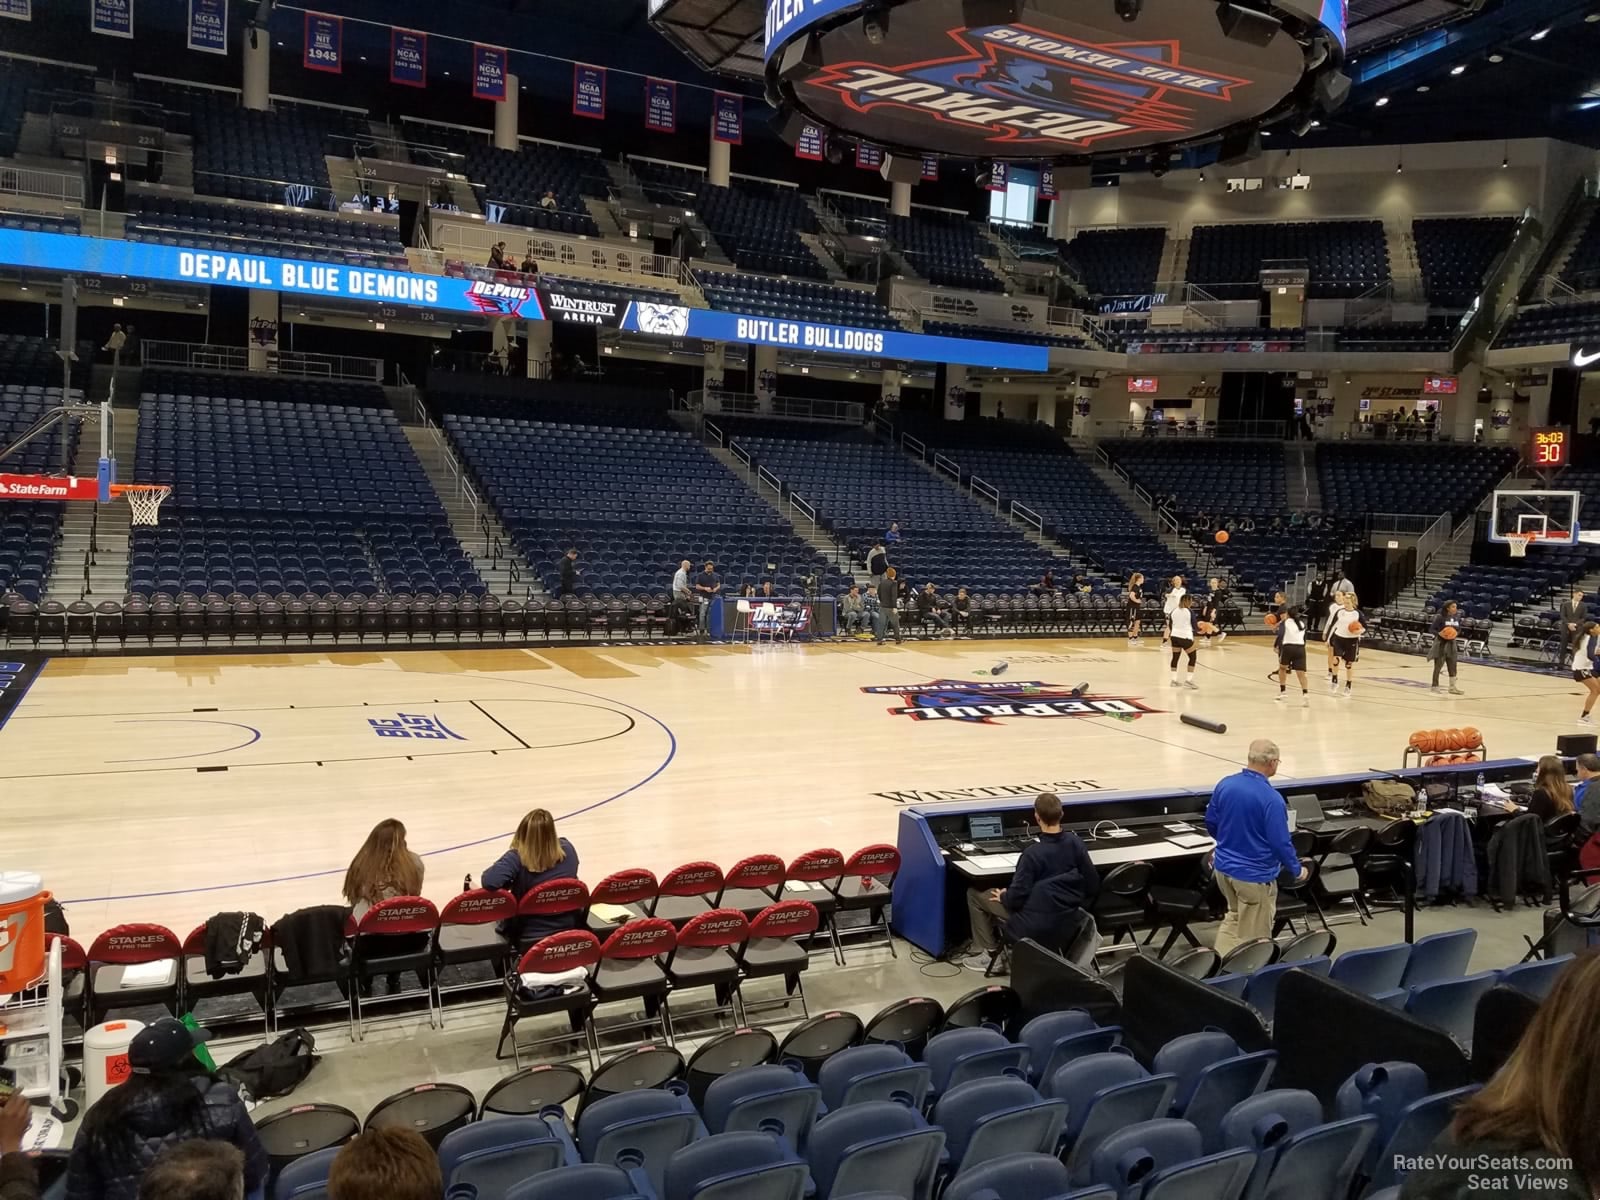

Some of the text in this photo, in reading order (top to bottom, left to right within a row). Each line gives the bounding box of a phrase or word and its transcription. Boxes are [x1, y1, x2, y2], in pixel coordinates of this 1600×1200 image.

[195, 14, 221, 25] NCAA
[316, 34, 331, 44] NIT
[308, 48, 338, 62] 1945
[397, 49, 420, 60] NCAA
[984, 29, 1221, 88] BLUE DEMONS
[479, 64, 501, 75] NCAA
[579, 82, 600, 93] NCAA
[651, 97, 671, 106] NCAA
[838, 69, 1134, 139] DEPAUL
[718, 110, 738, 120] NCAA
[992, 163, 1005, 176] 24
[179, 252, 438, 302] DEPAUL BLUE DEMONS
[550, 293, 616, 315] WINTRUST
[563, 311, 603, 324] ARENA
[737, 318, 883, 353] BUTLER BULLDOGS
[1536, 431, 1564, 444] 36:03
[1539, 444, 1560, 462] 30
[904, 699, 1144, 719] DEPAUL
[367, 718, 413, 738] BIG
[397, 712, 448, 739] EAST
[870, 779, 1104, 804] WINTRUST
[804, 856, 840, 866] STAPLES
[860, 852, 895, 861] STAPLES
[743, 863, 780, 873] STAPLES
[677, 870, 716, 880] STAPLES
[610, 877, 651, 889] STAPLES
[537, 888, 581, 899] STAPLES
[459, 896, 506, 908] STAPLES
[378, 906, 428, 917] STAPLES
[768, 909, 810, 921] STAPLES
[700, 919, 742, 930] STAPLES
[109, 935, 165, 944] STAPLES
[623, 929, 668, 941] STAPLES
[544, 940, 593, 955] STAPLES
